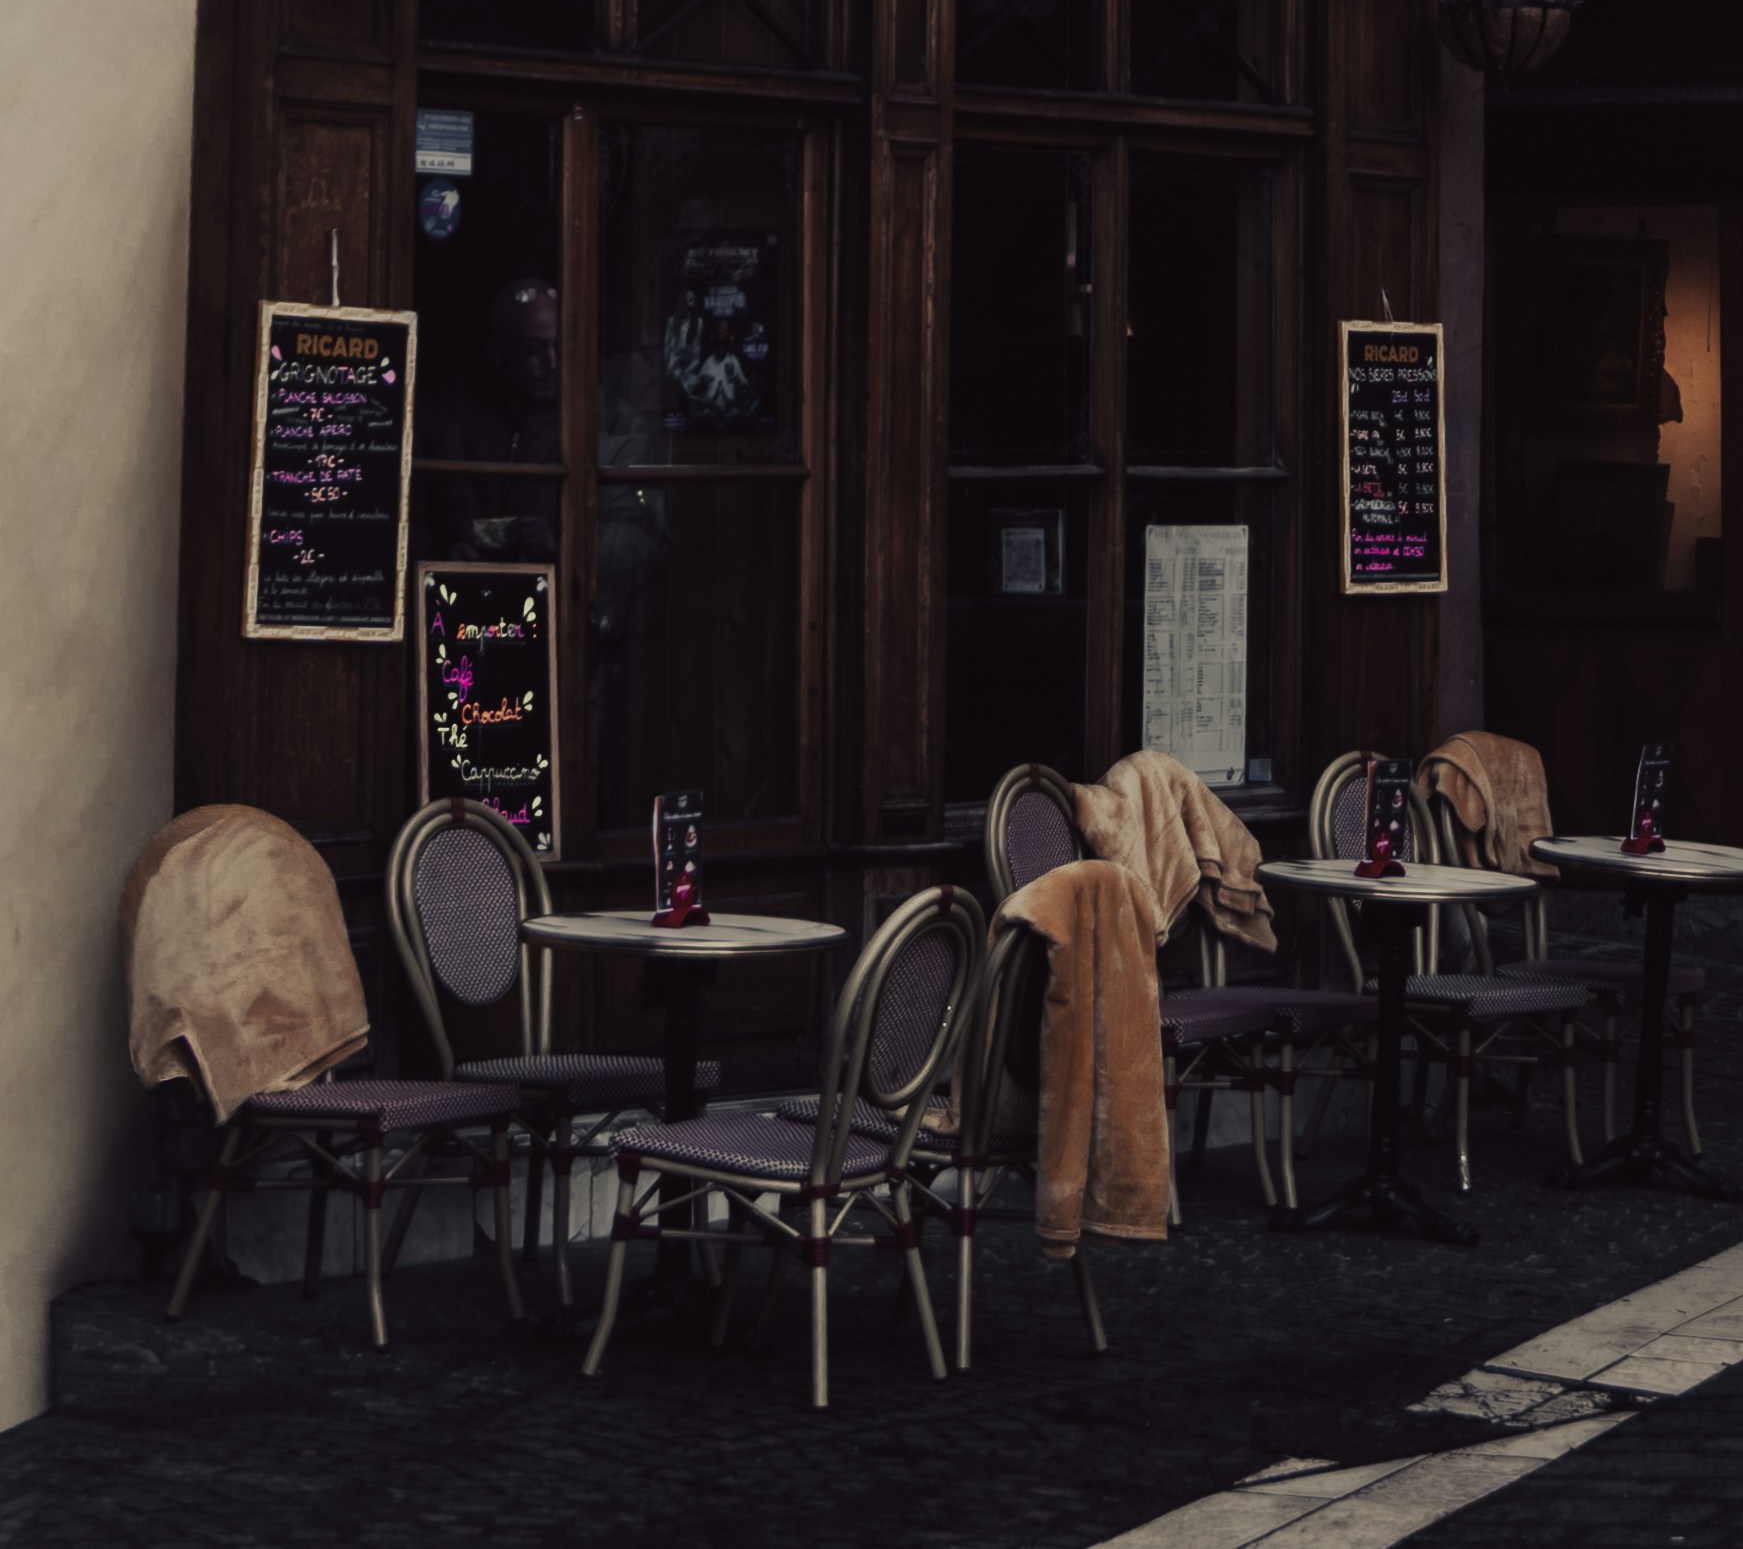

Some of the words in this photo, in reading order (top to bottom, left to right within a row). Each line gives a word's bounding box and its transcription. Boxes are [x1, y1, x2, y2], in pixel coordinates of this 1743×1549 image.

[296, 332, 380, 359] RICARD
[1363, 344, 1419, 363] RICARD
[279, 361, 378, 385] GRIGNOTAGE
[269, 529, 304, 545] CHIPS
[442, 654, 474, 704] Café
[461, 697, 523, 724] Chocolat
[437, 723, 470, 748] Thé
[461, 759, 541, 792] Cappuccino
